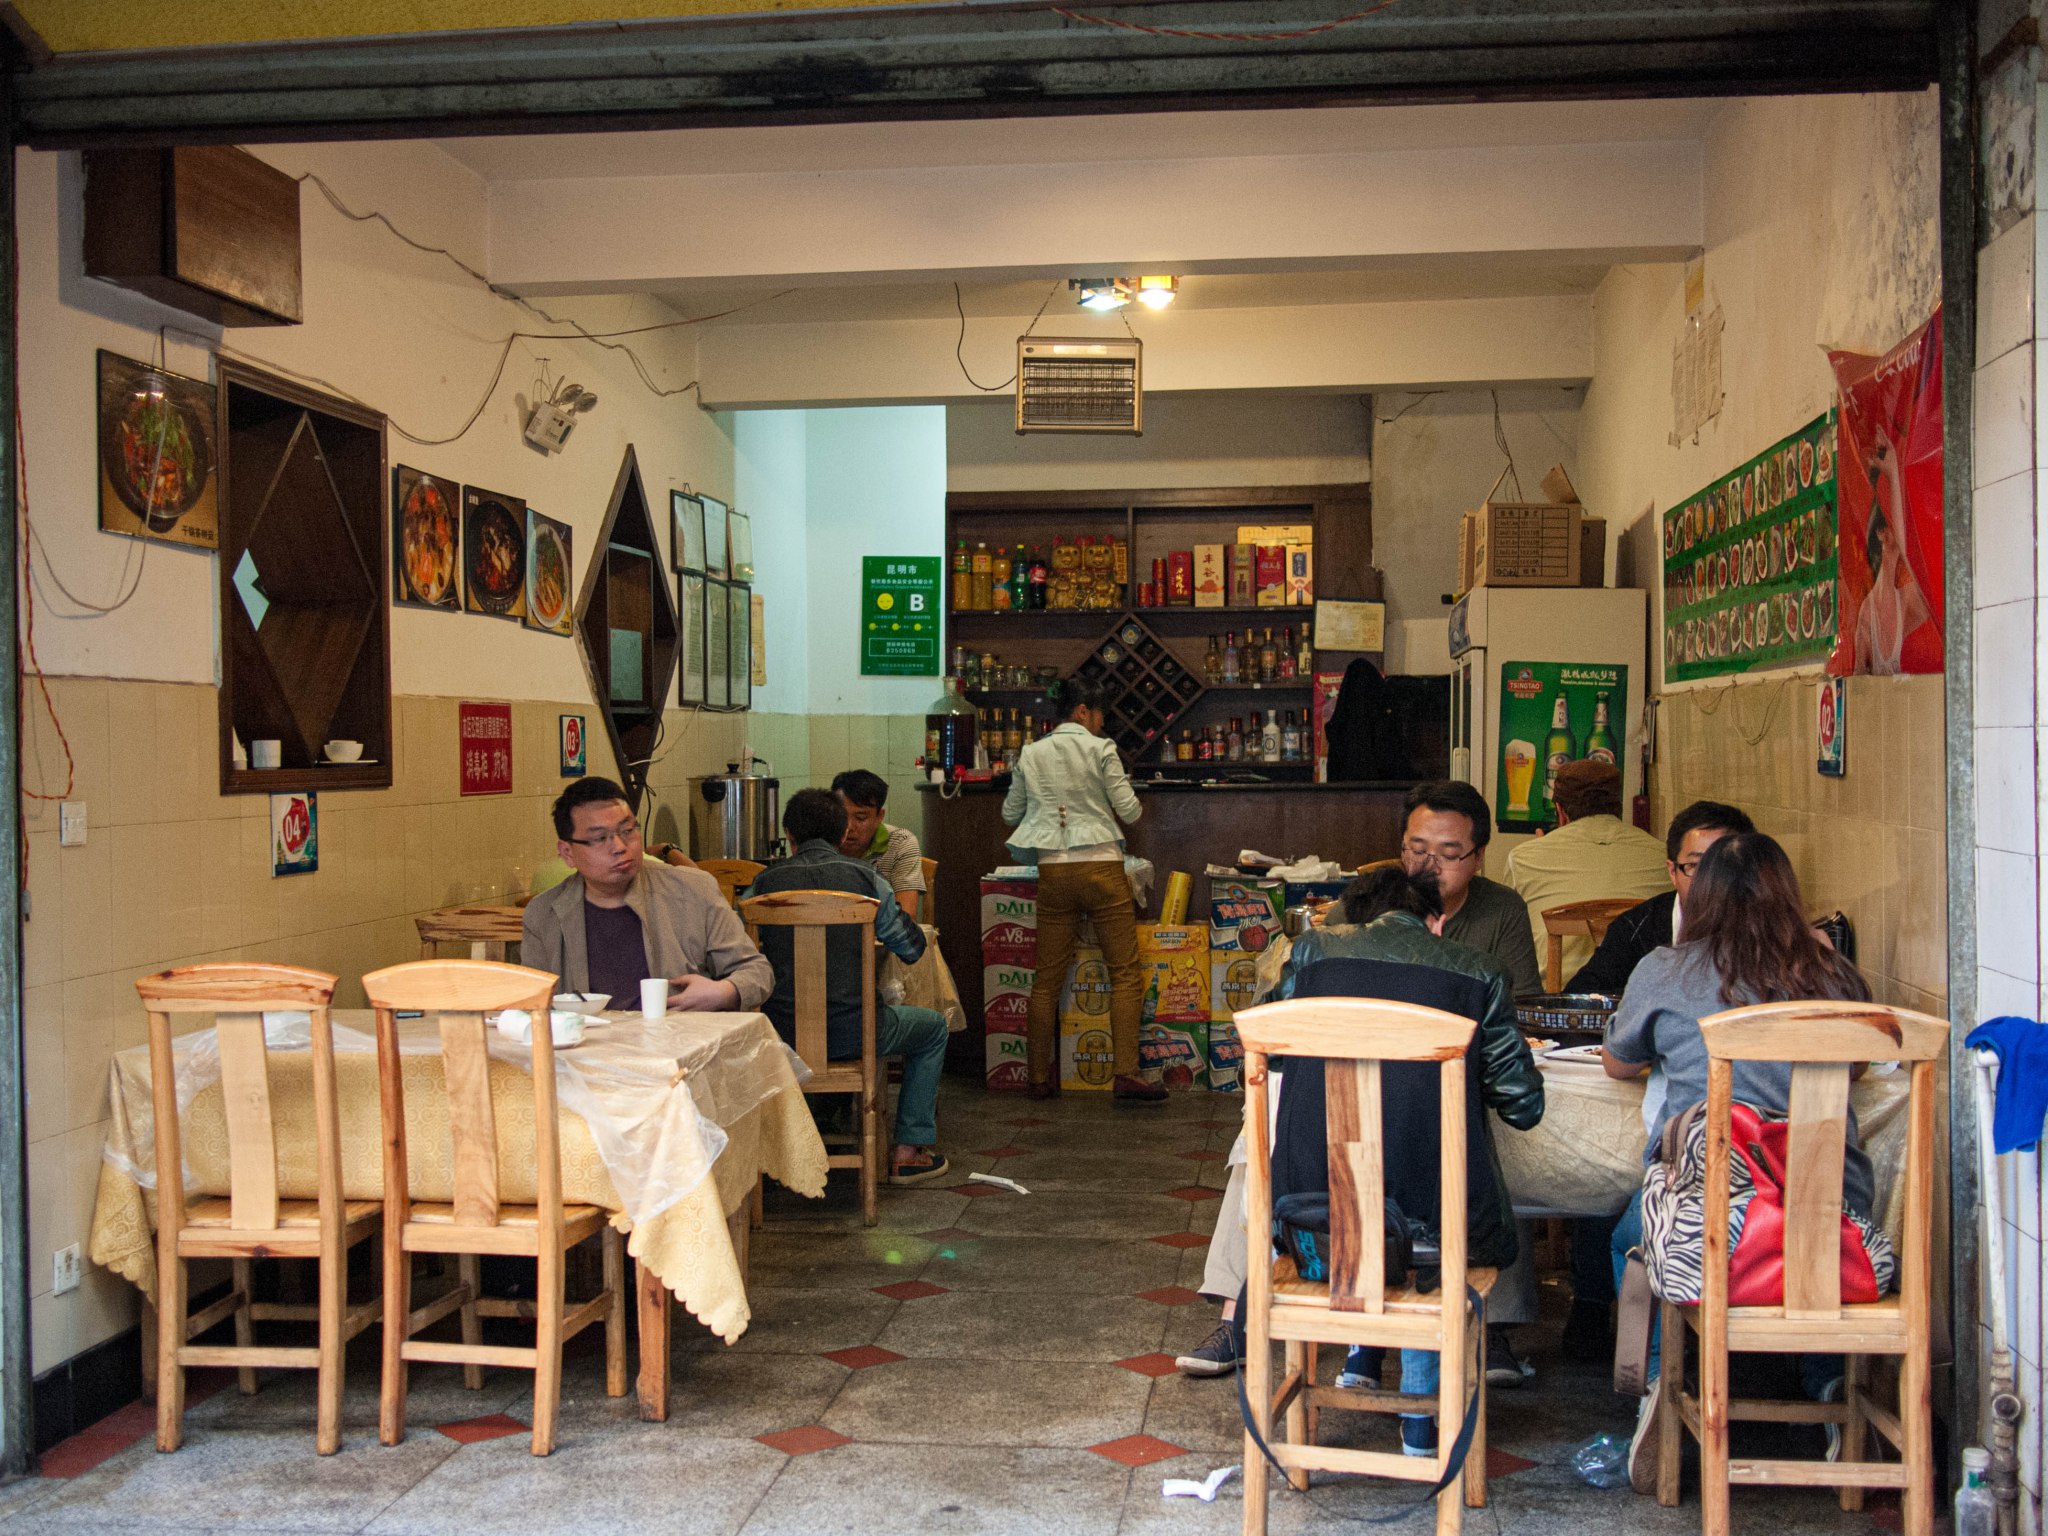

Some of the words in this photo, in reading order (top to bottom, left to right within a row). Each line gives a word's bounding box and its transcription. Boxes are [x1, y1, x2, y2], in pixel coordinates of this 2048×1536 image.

[886, 564, 918, 575] 昆明市
[909, 593, 925, 612] B
[1509, 681, 1541, 690] TSINGTAO
[1821, 703, 1832, 736] 02
[567, 730, 576, 752] 03
[466, 749, 489, 781] 消毒柜
[285, 814, 301, 843] 04
[995, 900, 1033, 914] DALI
[1005, 927, 1025, 944] V8
[1008, 998, 1028, 1014] V8
[1000, 1040, 1029, 1053] DA
[1010, 1067, 1029, 1083] V8
